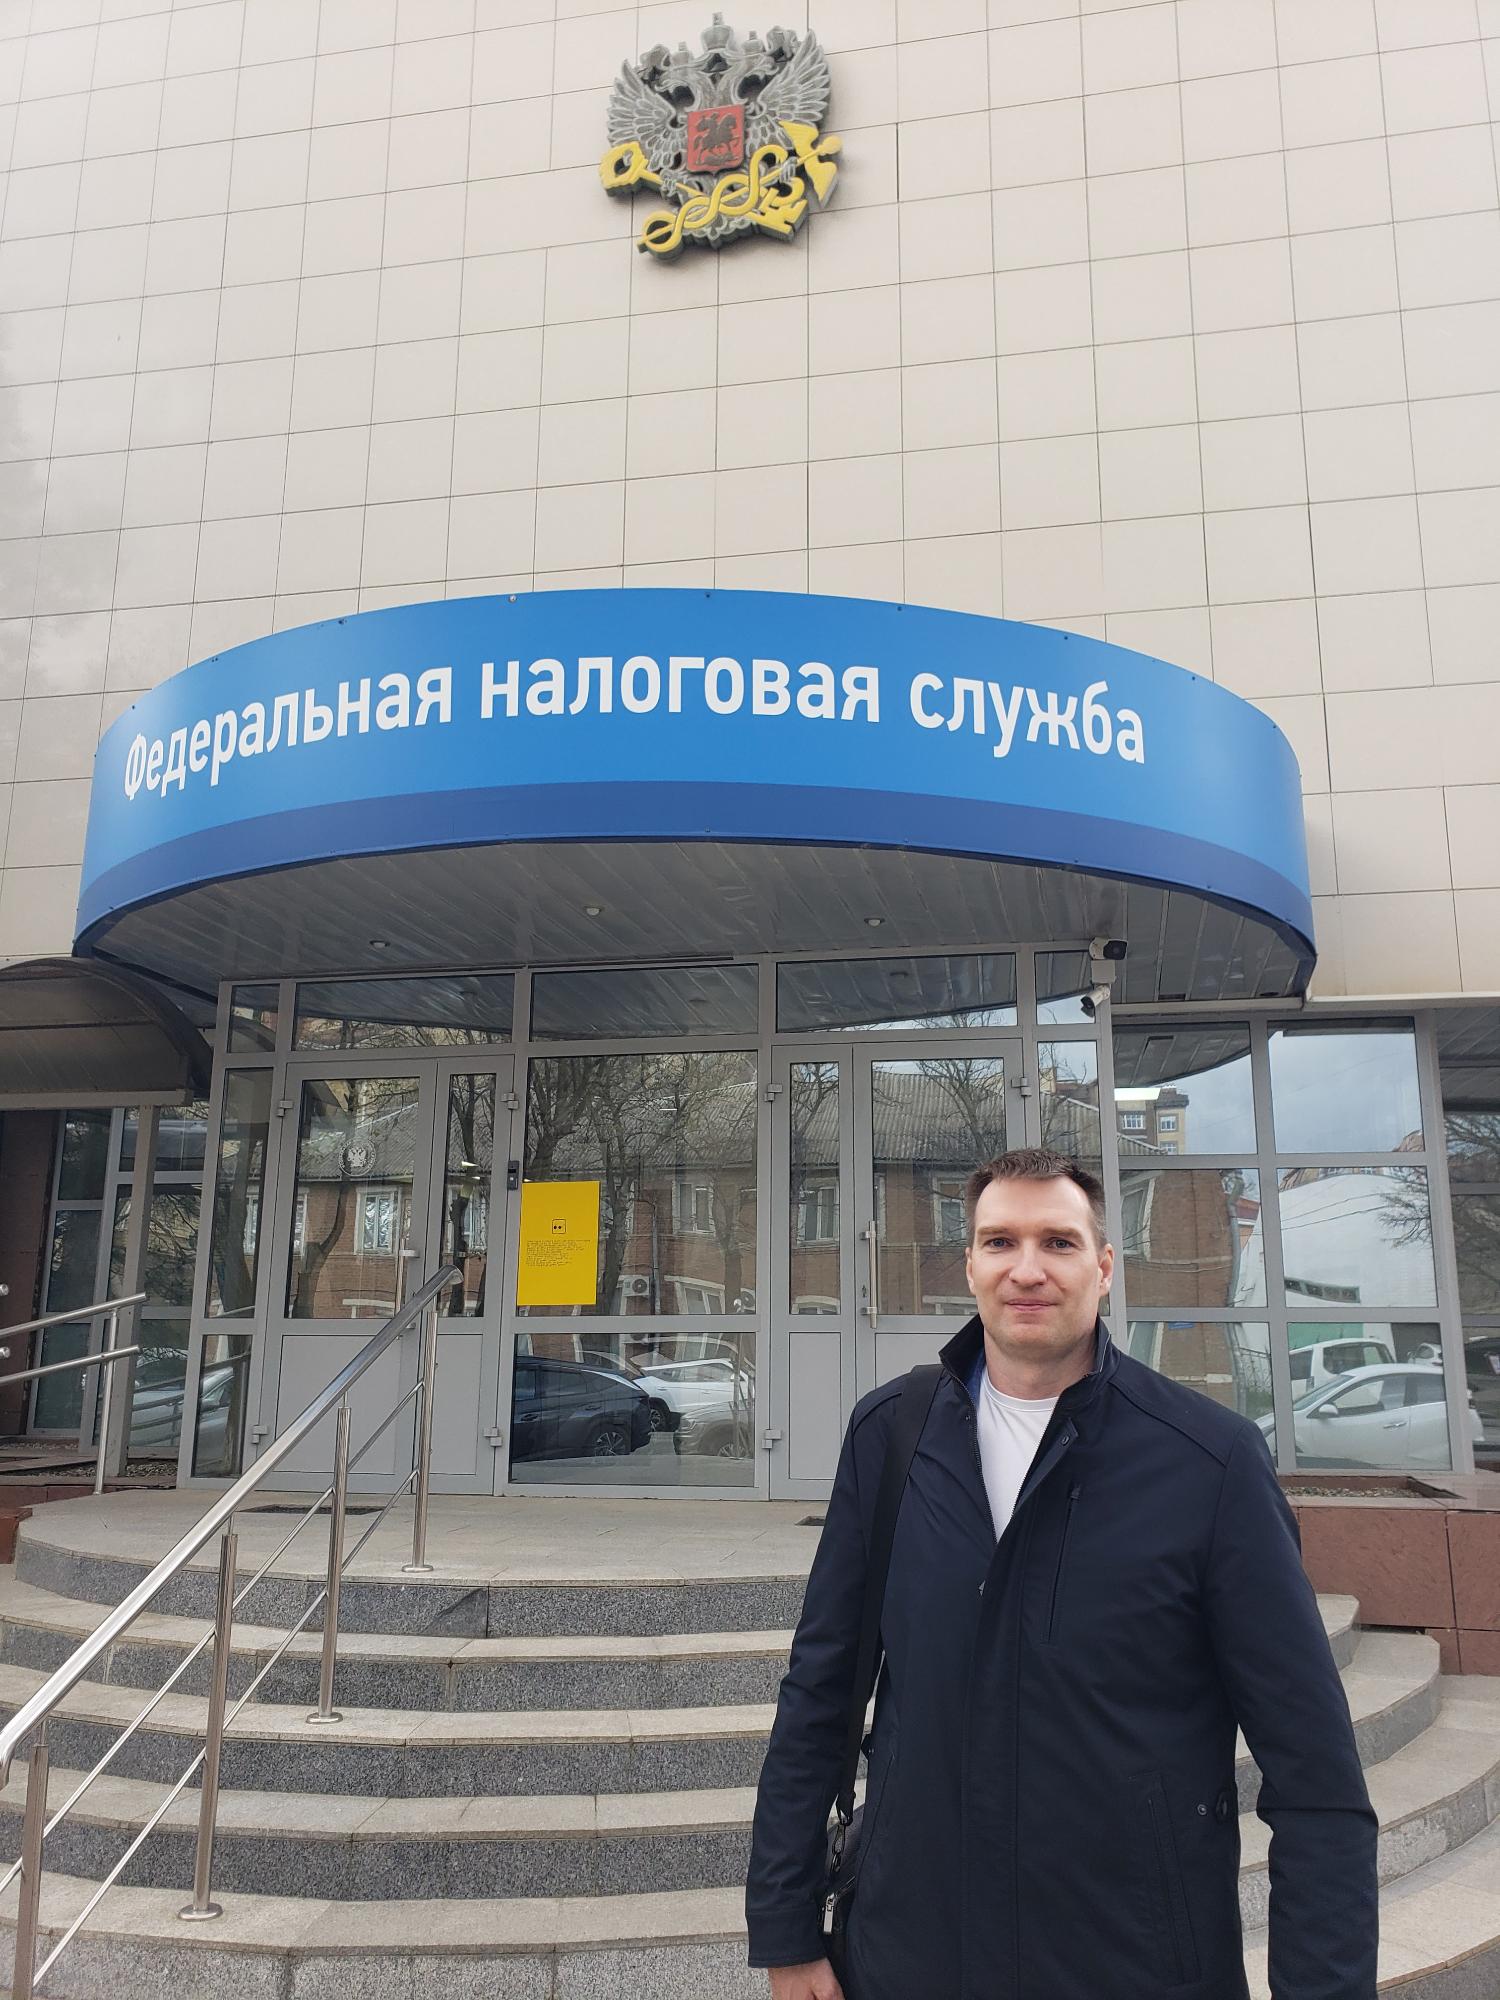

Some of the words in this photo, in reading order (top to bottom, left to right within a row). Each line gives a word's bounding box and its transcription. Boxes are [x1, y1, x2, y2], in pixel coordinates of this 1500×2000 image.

[124, 667, 452, 800] Федеральная
[480, 655, 880, 722] налоговая
[909, 680, 1145, 764] служба
